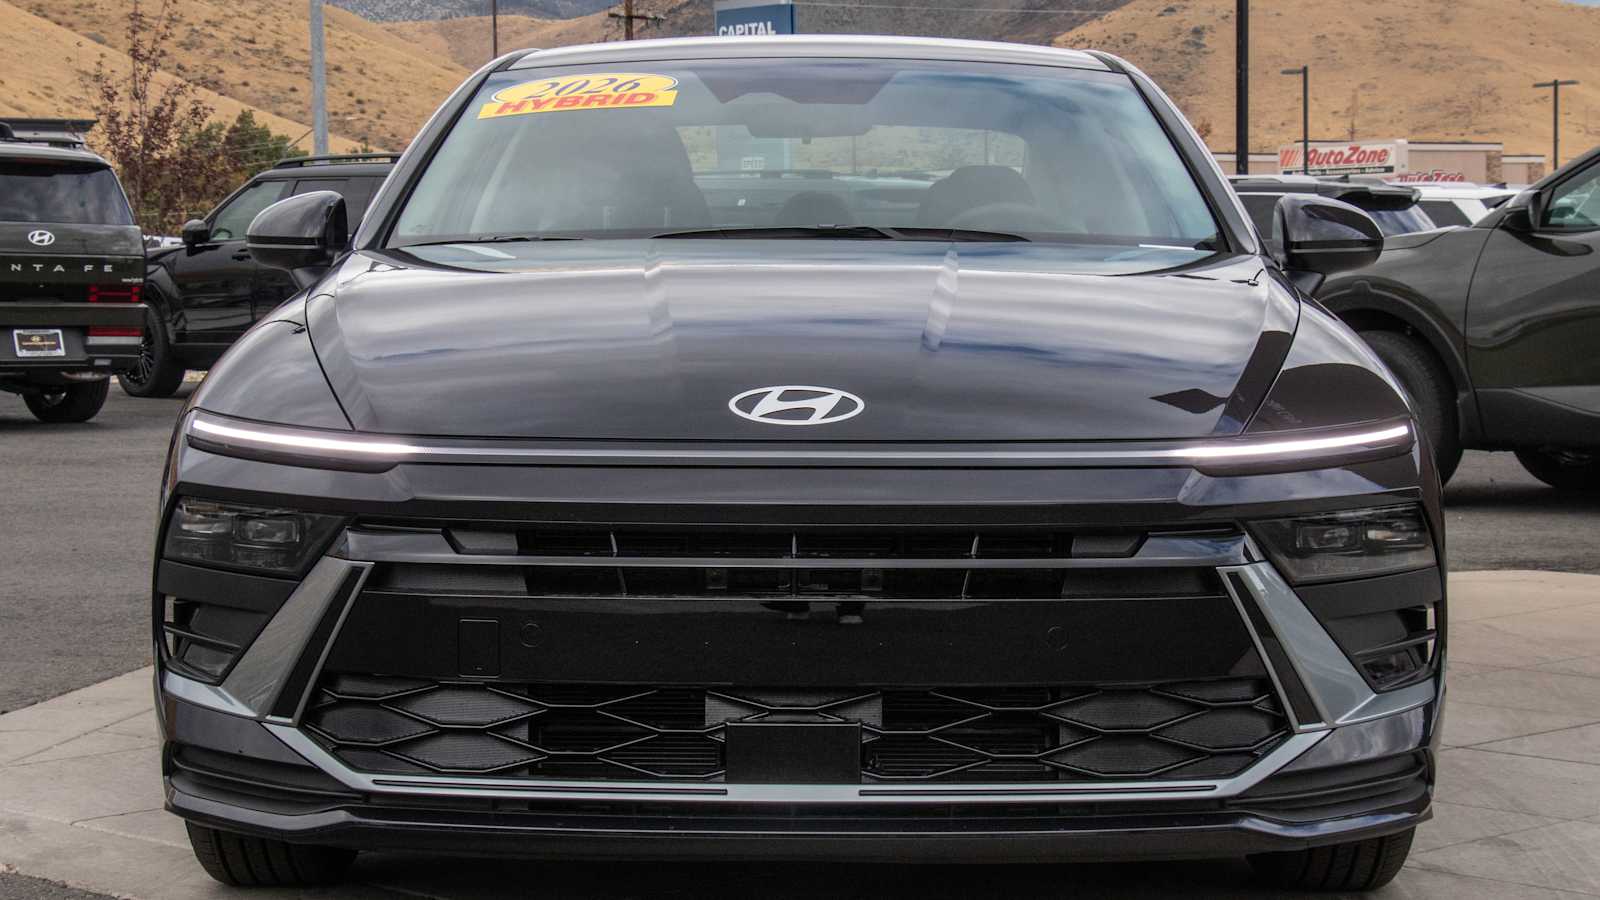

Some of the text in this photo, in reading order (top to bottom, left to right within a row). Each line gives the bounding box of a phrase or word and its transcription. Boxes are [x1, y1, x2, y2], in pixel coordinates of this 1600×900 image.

[718, 20, 776, 36] CAPITAL
[526, 77, 643, 99] 2026
[495, 92, 657, 115] HYBRID
[1308, 145, 1388, 165] AutoZone
[83, 264, 113, 273] FE
